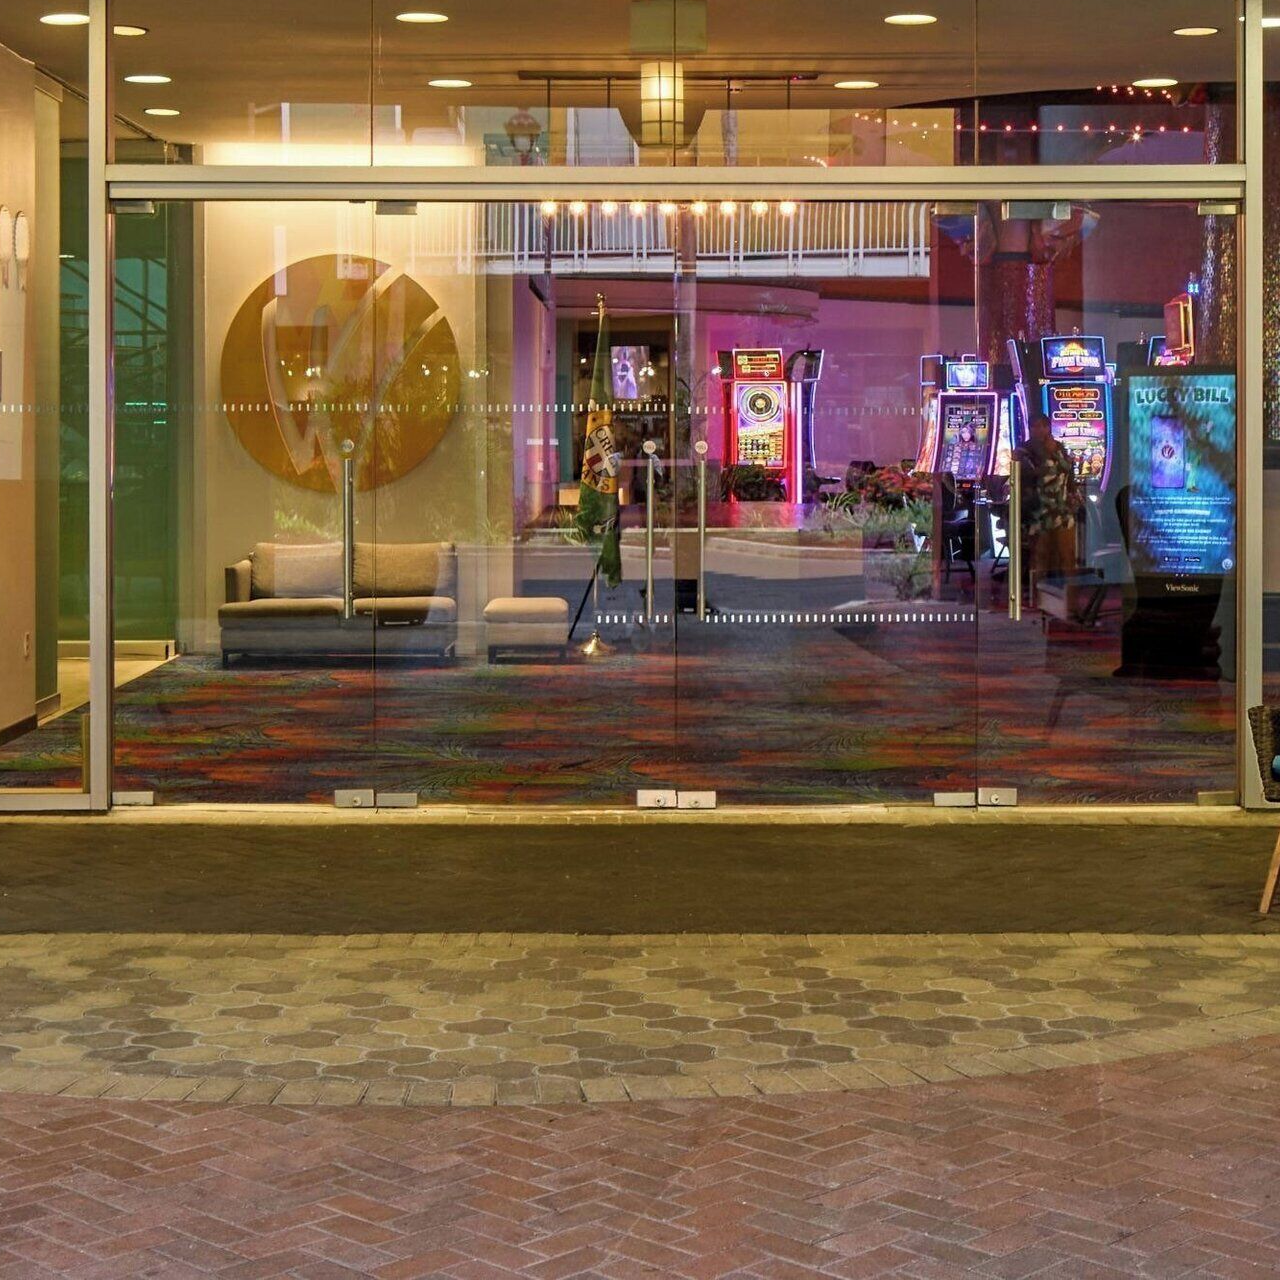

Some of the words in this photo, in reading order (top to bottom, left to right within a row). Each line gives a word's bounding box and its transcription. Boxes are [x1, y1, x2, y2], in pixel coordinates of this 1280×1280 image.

[1135, 387, 1188, 405] LUCY
[1193, 385, 1231, 404] BILL
[1166, 583, 1200, 592] ViewSonic
